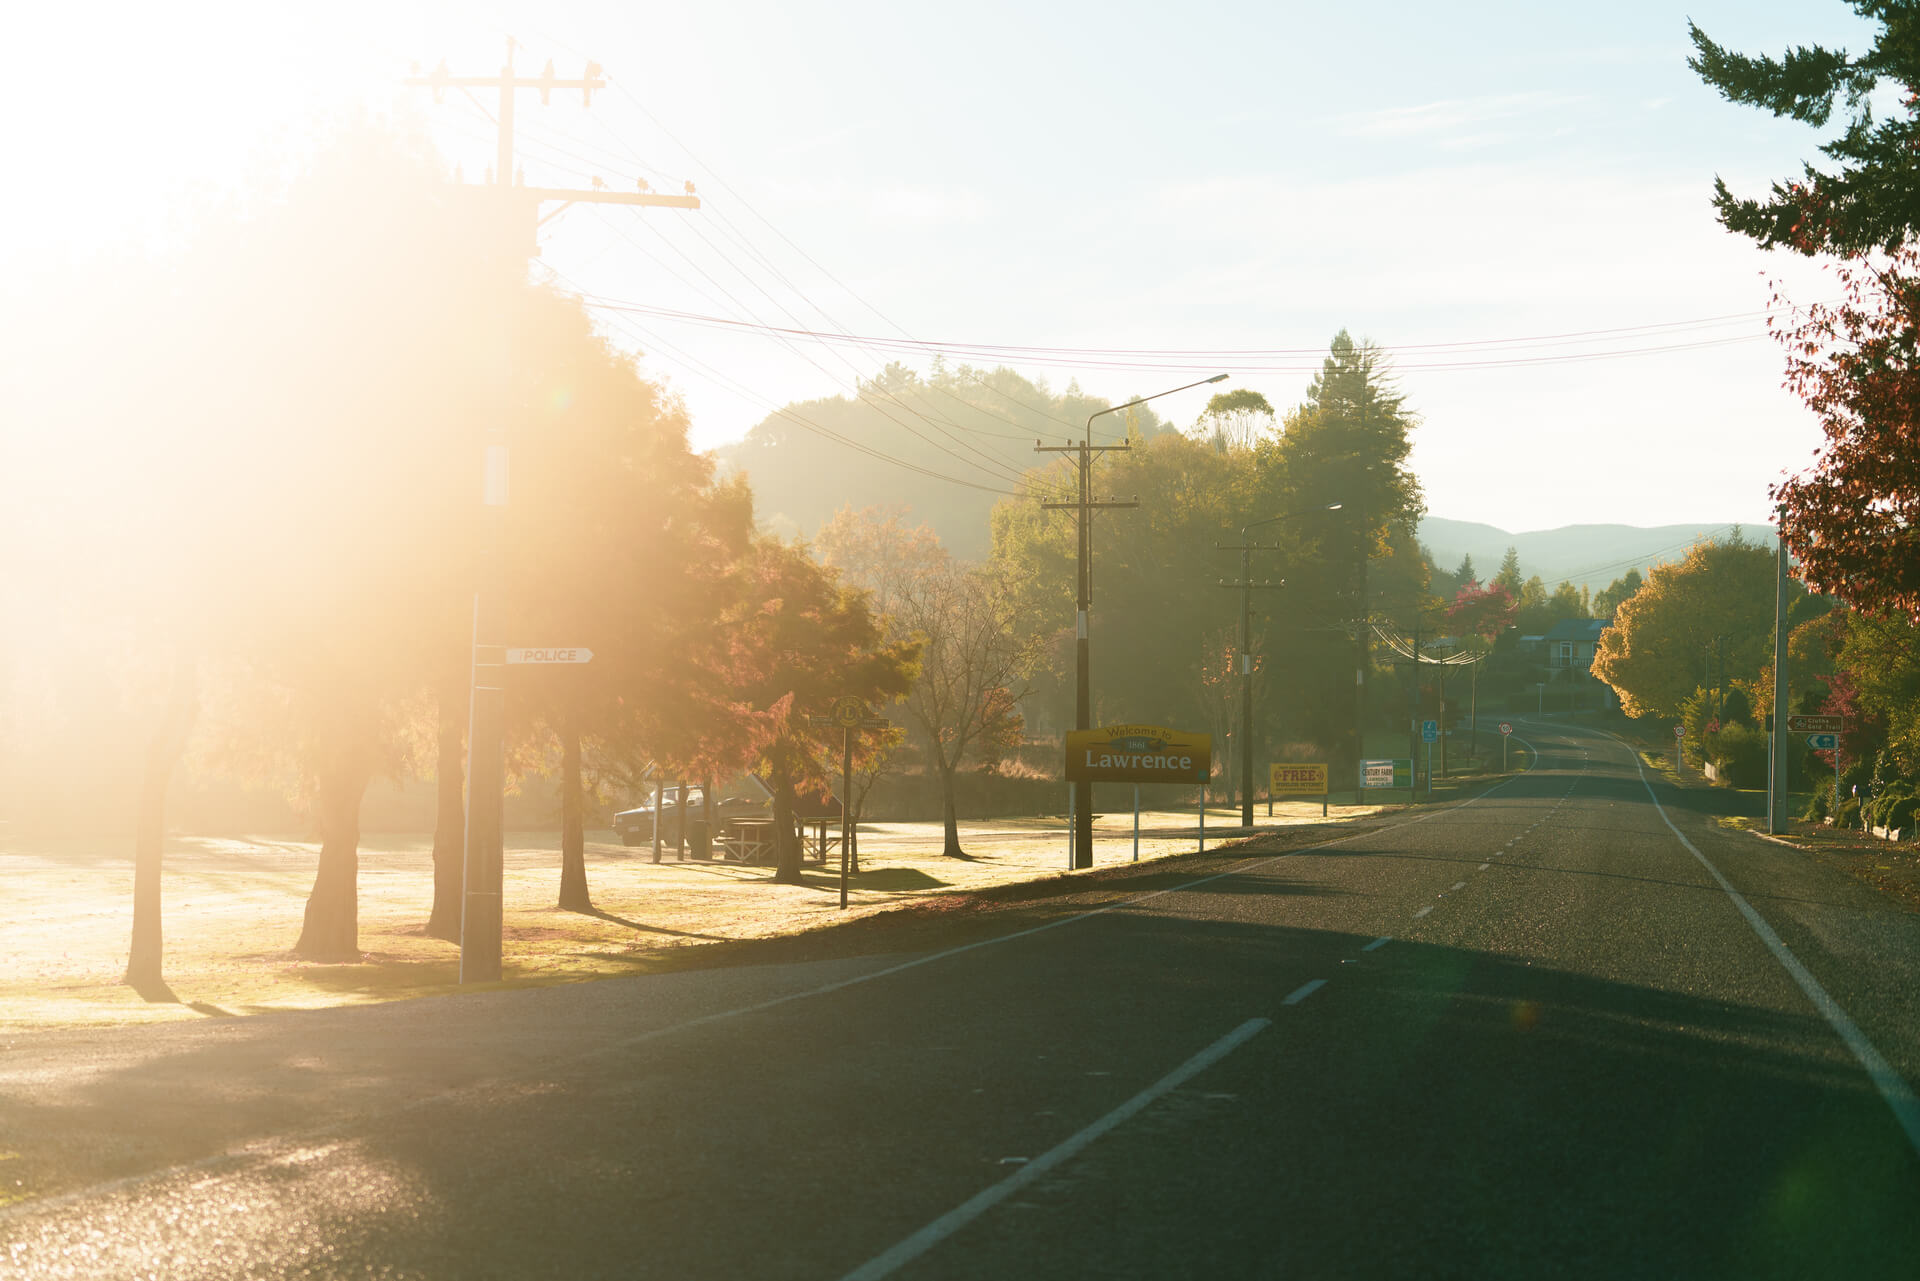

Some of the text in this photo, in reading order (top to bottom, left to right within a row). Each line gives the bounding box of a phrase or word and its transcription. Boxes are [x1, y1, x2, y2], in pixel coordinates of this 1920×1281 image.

[524, 649, 577, 661] POLICE
[1106, 726, 1172, 740] Welcome to
[1085, 750, 1192, 769] Lawrence
[1282, 769, 1316, 781] FREE
